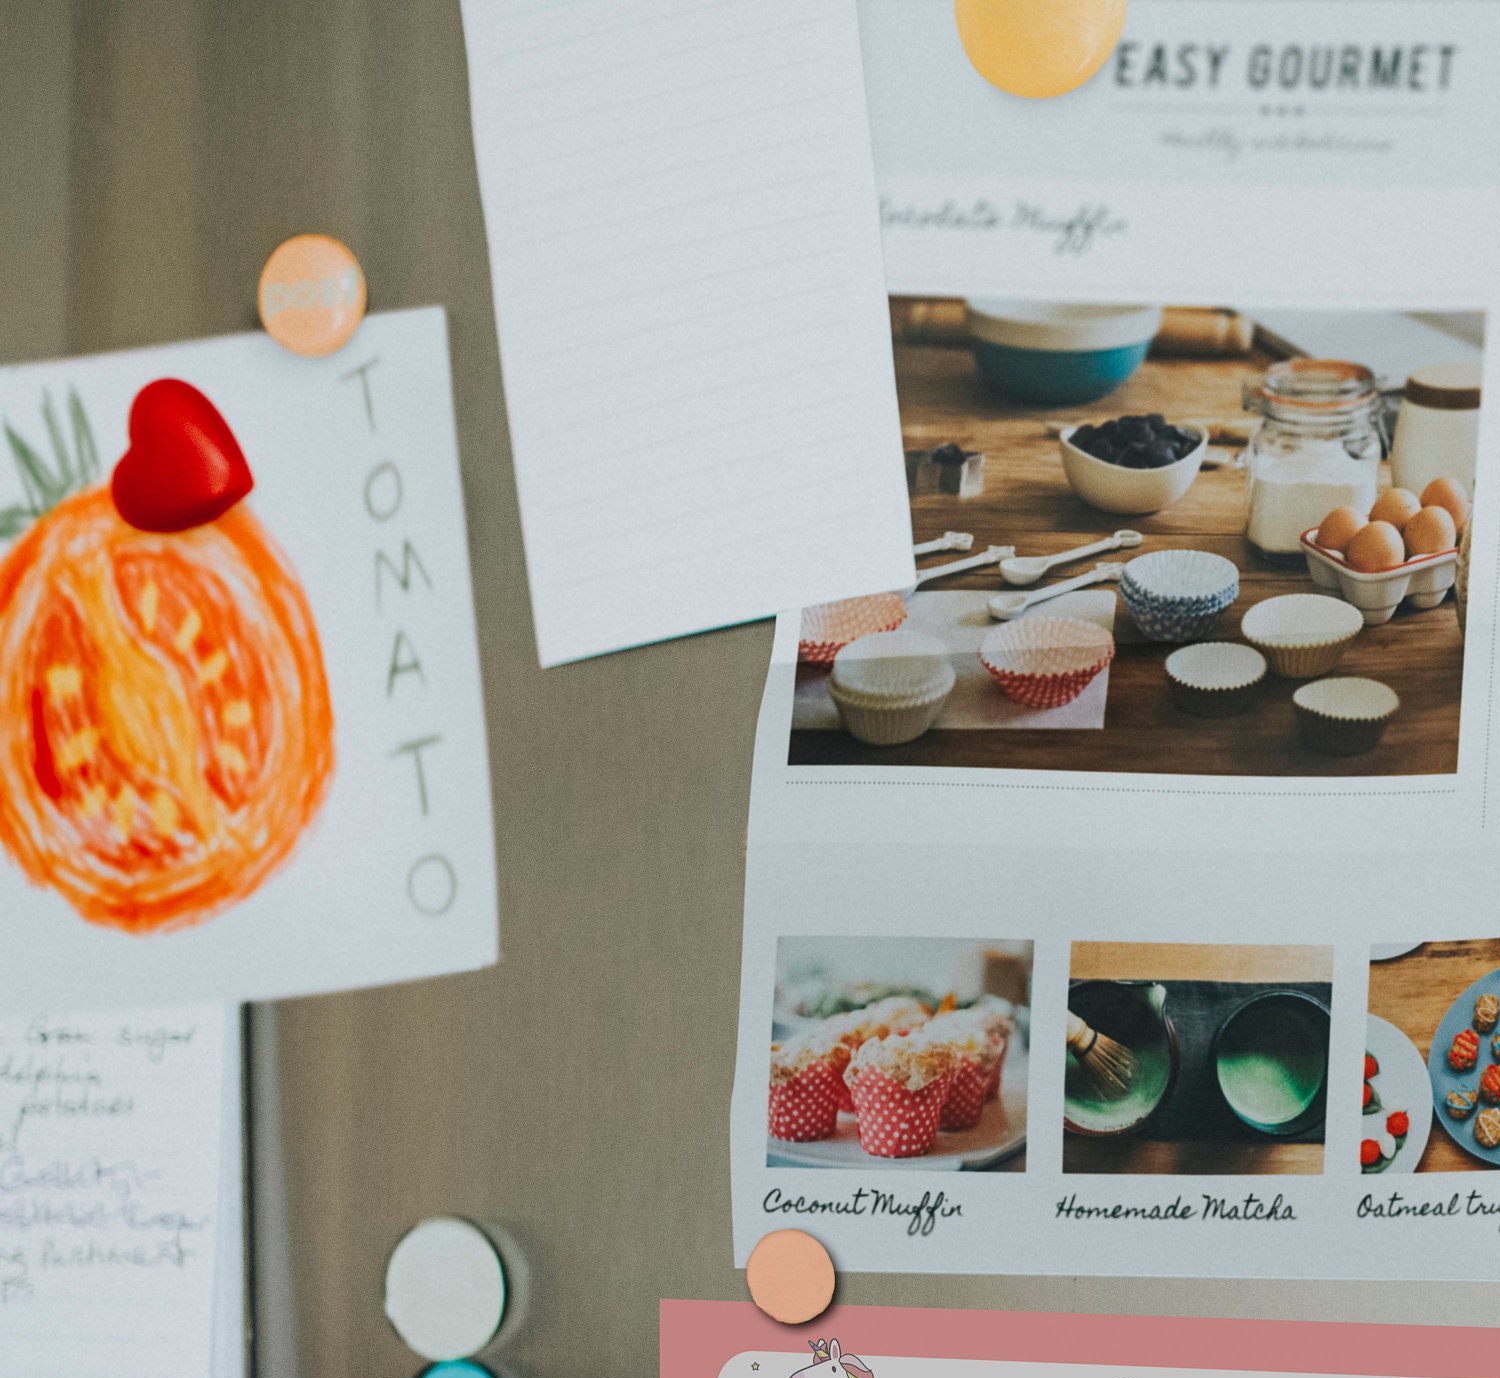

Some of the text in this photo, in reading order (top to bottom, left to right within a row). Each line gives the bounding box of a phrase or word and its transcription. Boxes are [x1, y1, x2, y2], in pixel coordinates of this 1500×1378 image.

[1113, 42, 1456, 90] EASY GOURMET
[340, 357, 457, 917] TOMATO
[763, 1187, 964, 1237] Coconut Muffin
[1055, 1193, 1298, 1221] Homemade Matcha
[1357, 1192, 1462, 1218] Oatmeal
